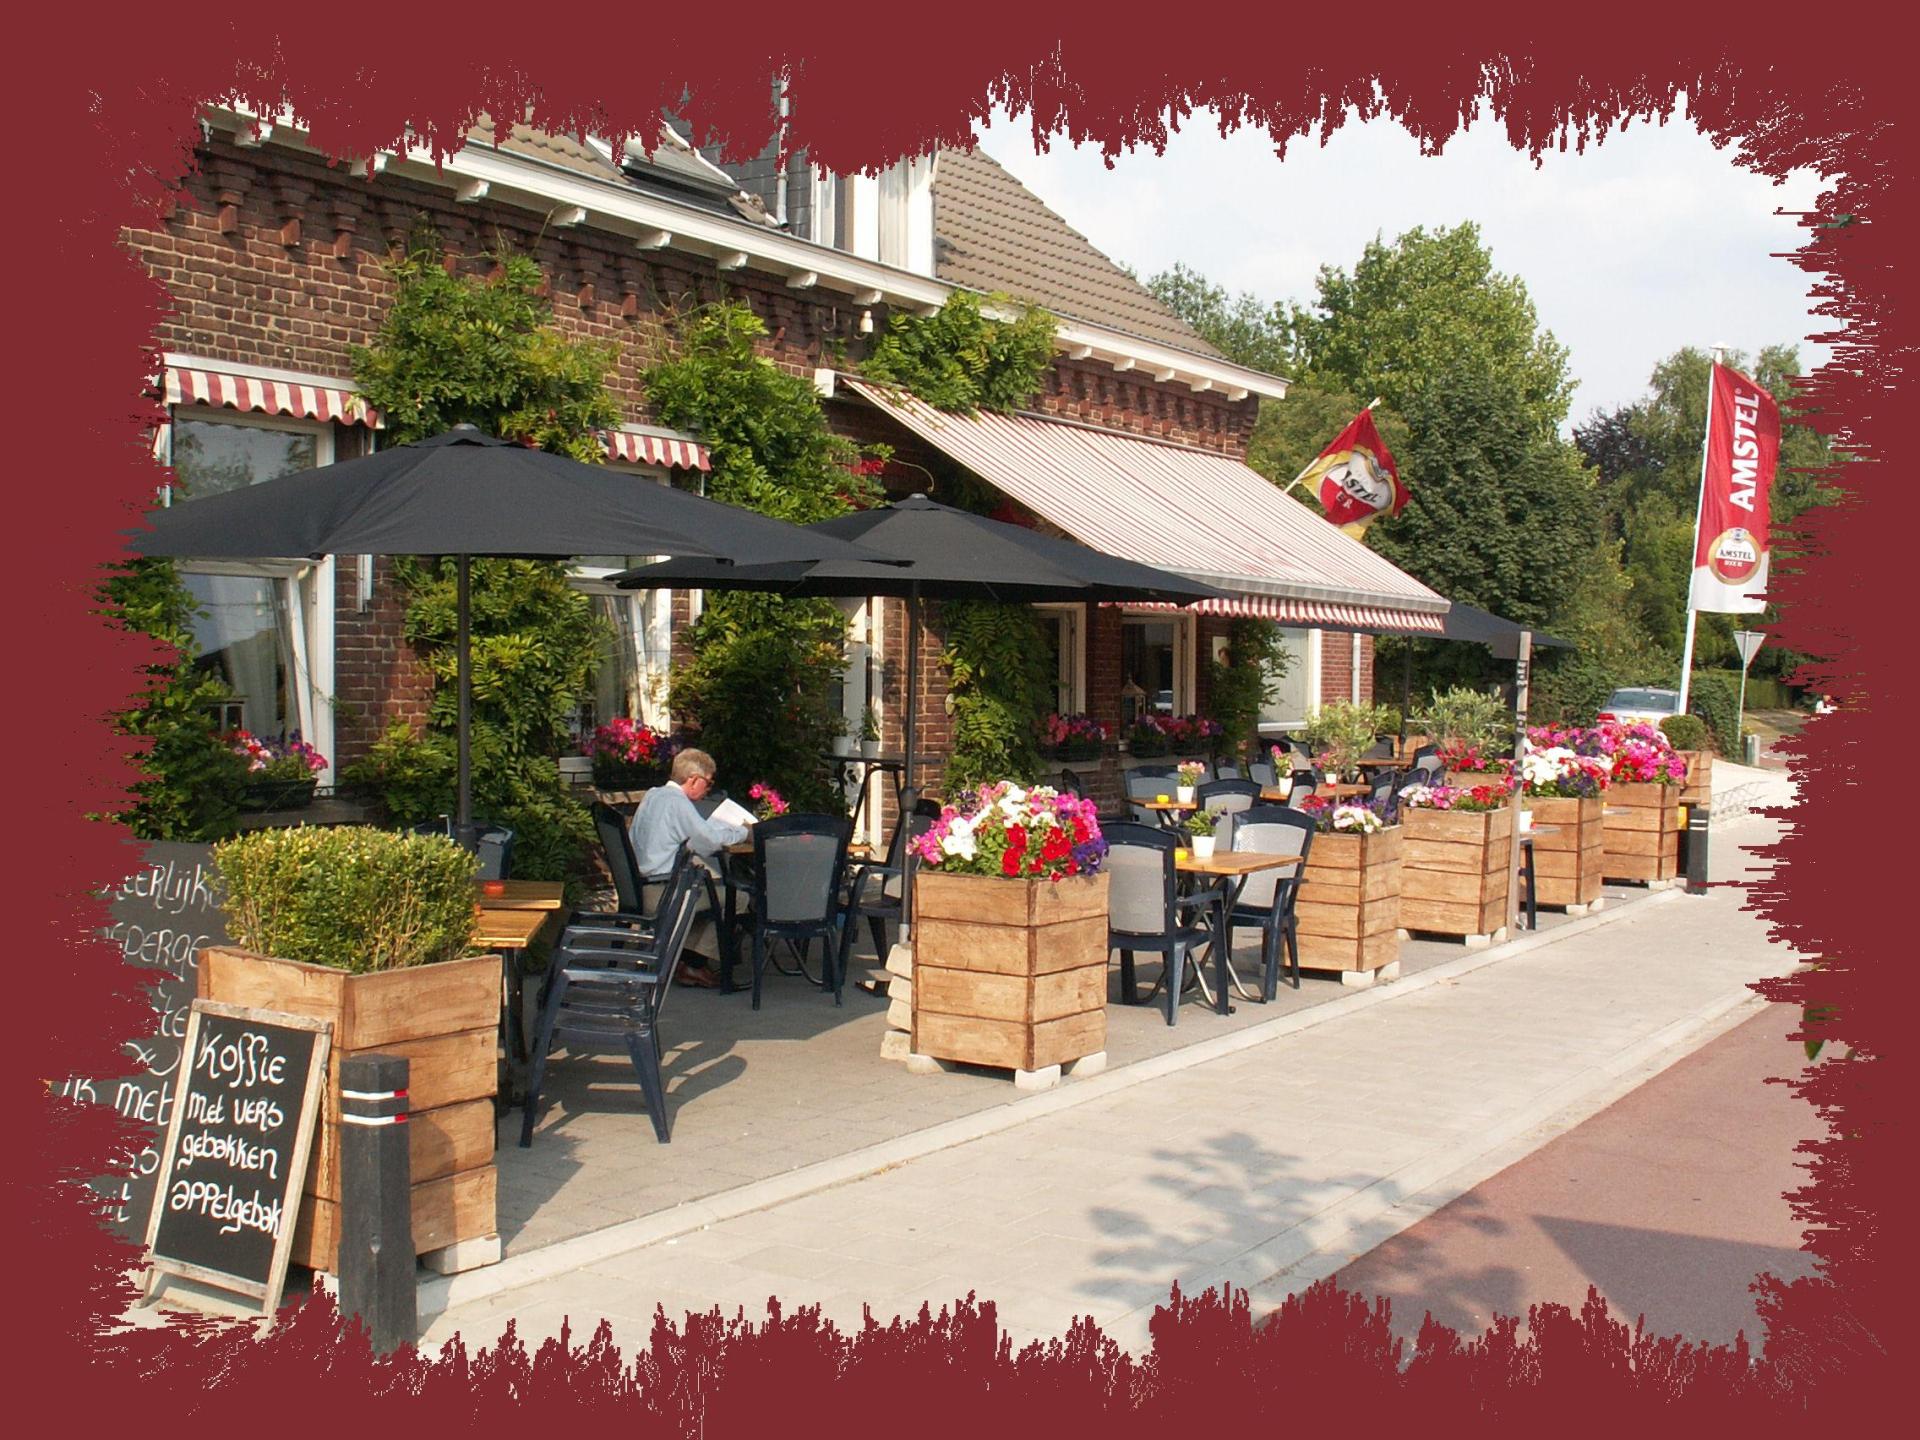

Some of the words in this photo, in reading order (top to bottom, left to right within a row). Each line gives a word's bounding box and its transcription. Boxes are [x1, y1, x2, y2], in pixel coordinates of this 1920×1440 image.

[1729, 393, 1760, 513] AMSTEL
[1720, 549, 1752, 560] AMSTEL
[177, 1129, 277, 1179] gebakken
